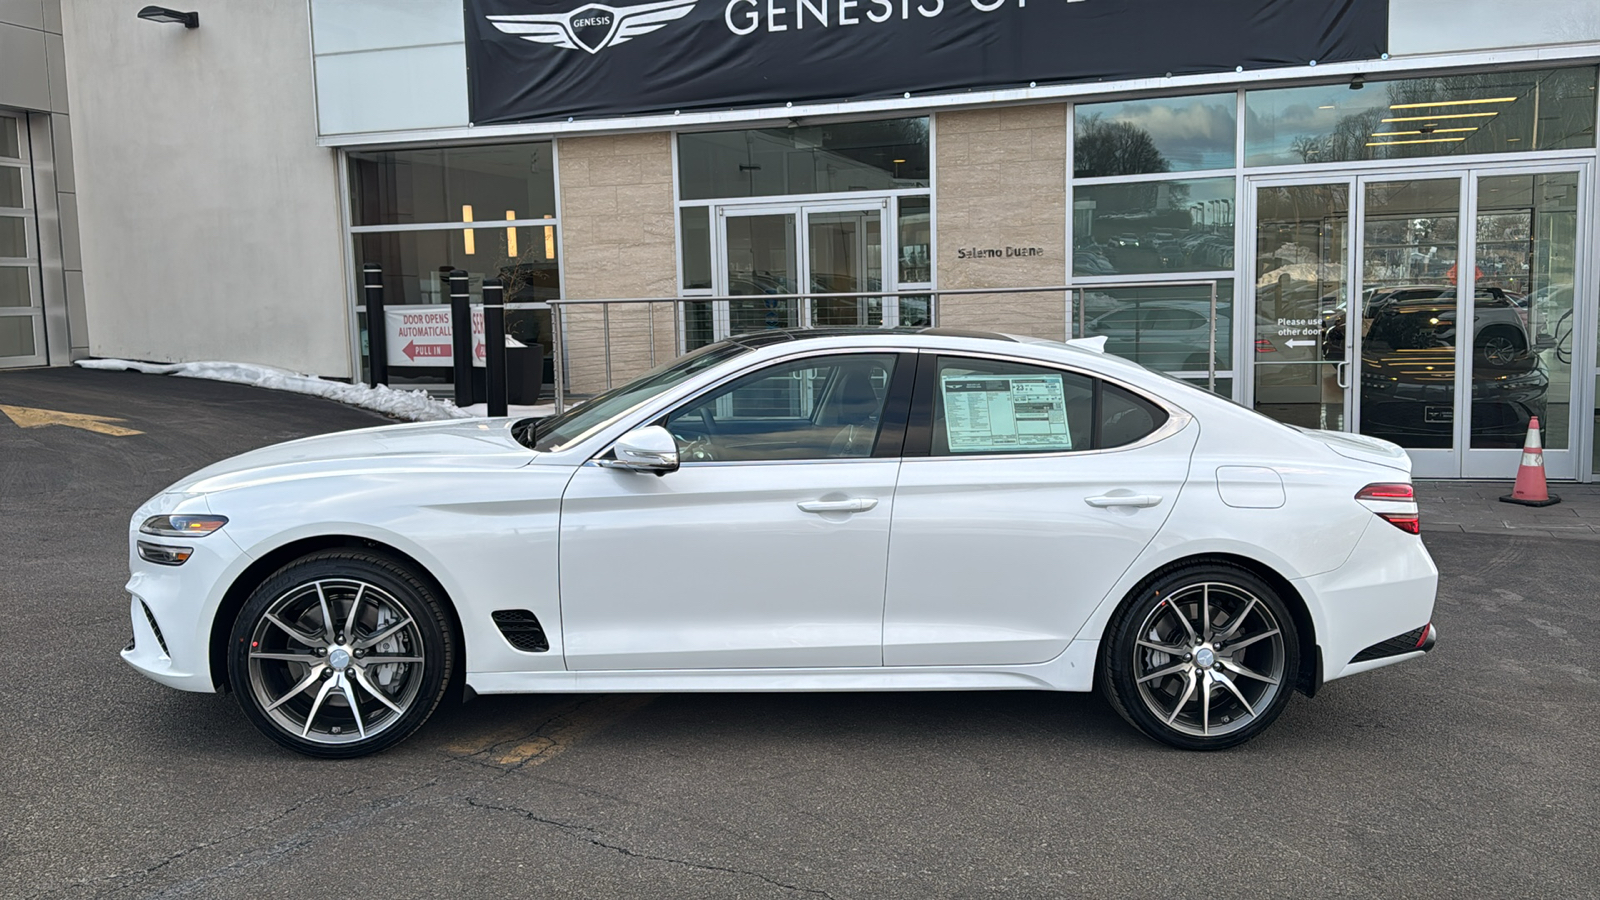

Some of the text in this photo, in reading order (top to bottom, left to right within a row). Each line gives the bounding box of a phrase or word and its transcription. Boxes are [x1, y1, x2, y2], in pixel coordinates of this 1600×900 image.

[573, 16, 610, 28] GENESIS
[1005, 246, 1044, 258] Duane
[403, 313, 449, 325] DOOR OPENS
[1277, 318, 1306, 326] Please
[398, 326, 453, 337] AUTOMATICALL
[1278, 327, 1322, 336] other door
[415, 345, 441, 355] PULL IN
